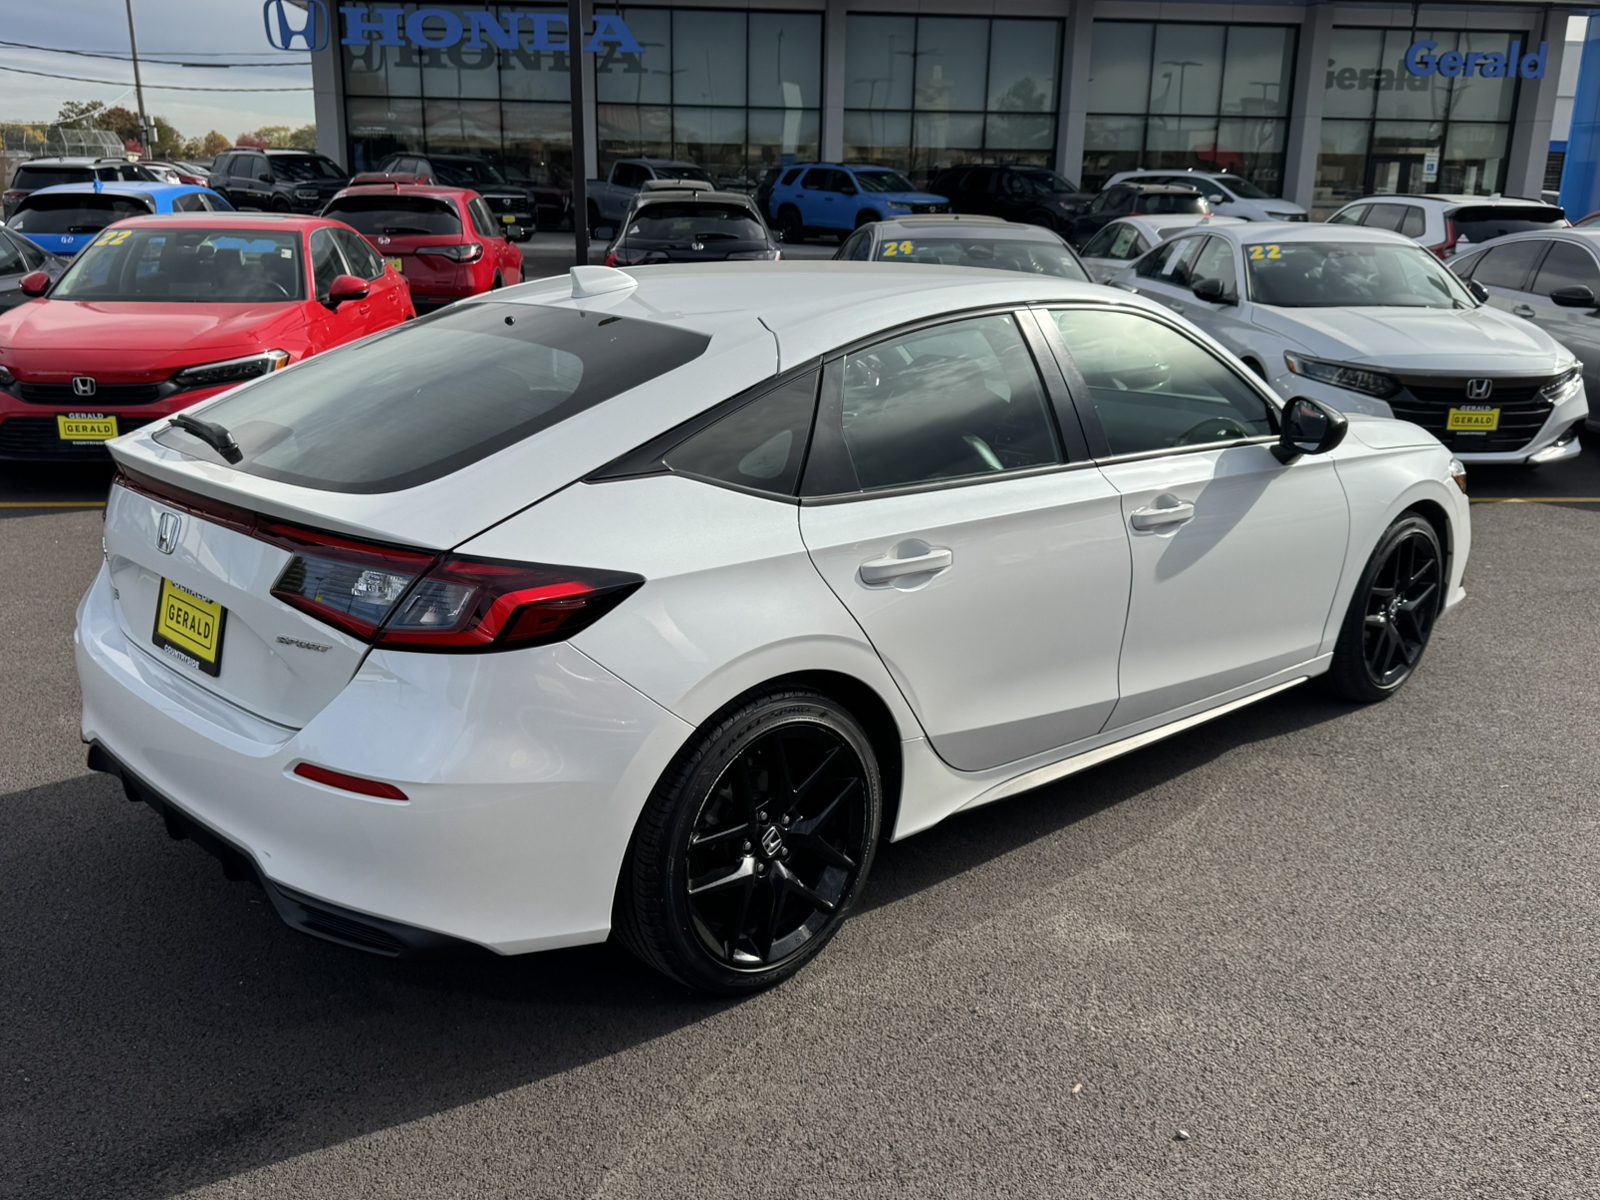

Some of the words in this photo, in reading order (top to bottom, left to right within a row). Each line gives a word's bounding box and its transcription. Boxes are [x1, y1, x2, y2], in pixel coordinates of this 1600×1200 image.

[338, 7, 646, 53] HONDA
[1405, 39, 1549, 79] Gerald
[94, 230, 132, 246] 22
[883, 240, 914, 257] 24
[1249, 245, 1283, 260] 22
[168, 604, 211, 640] GERALD
[275, 635, 333, 653] SPORT
[163, 644, 200, 670] COUNTRYSIDE
